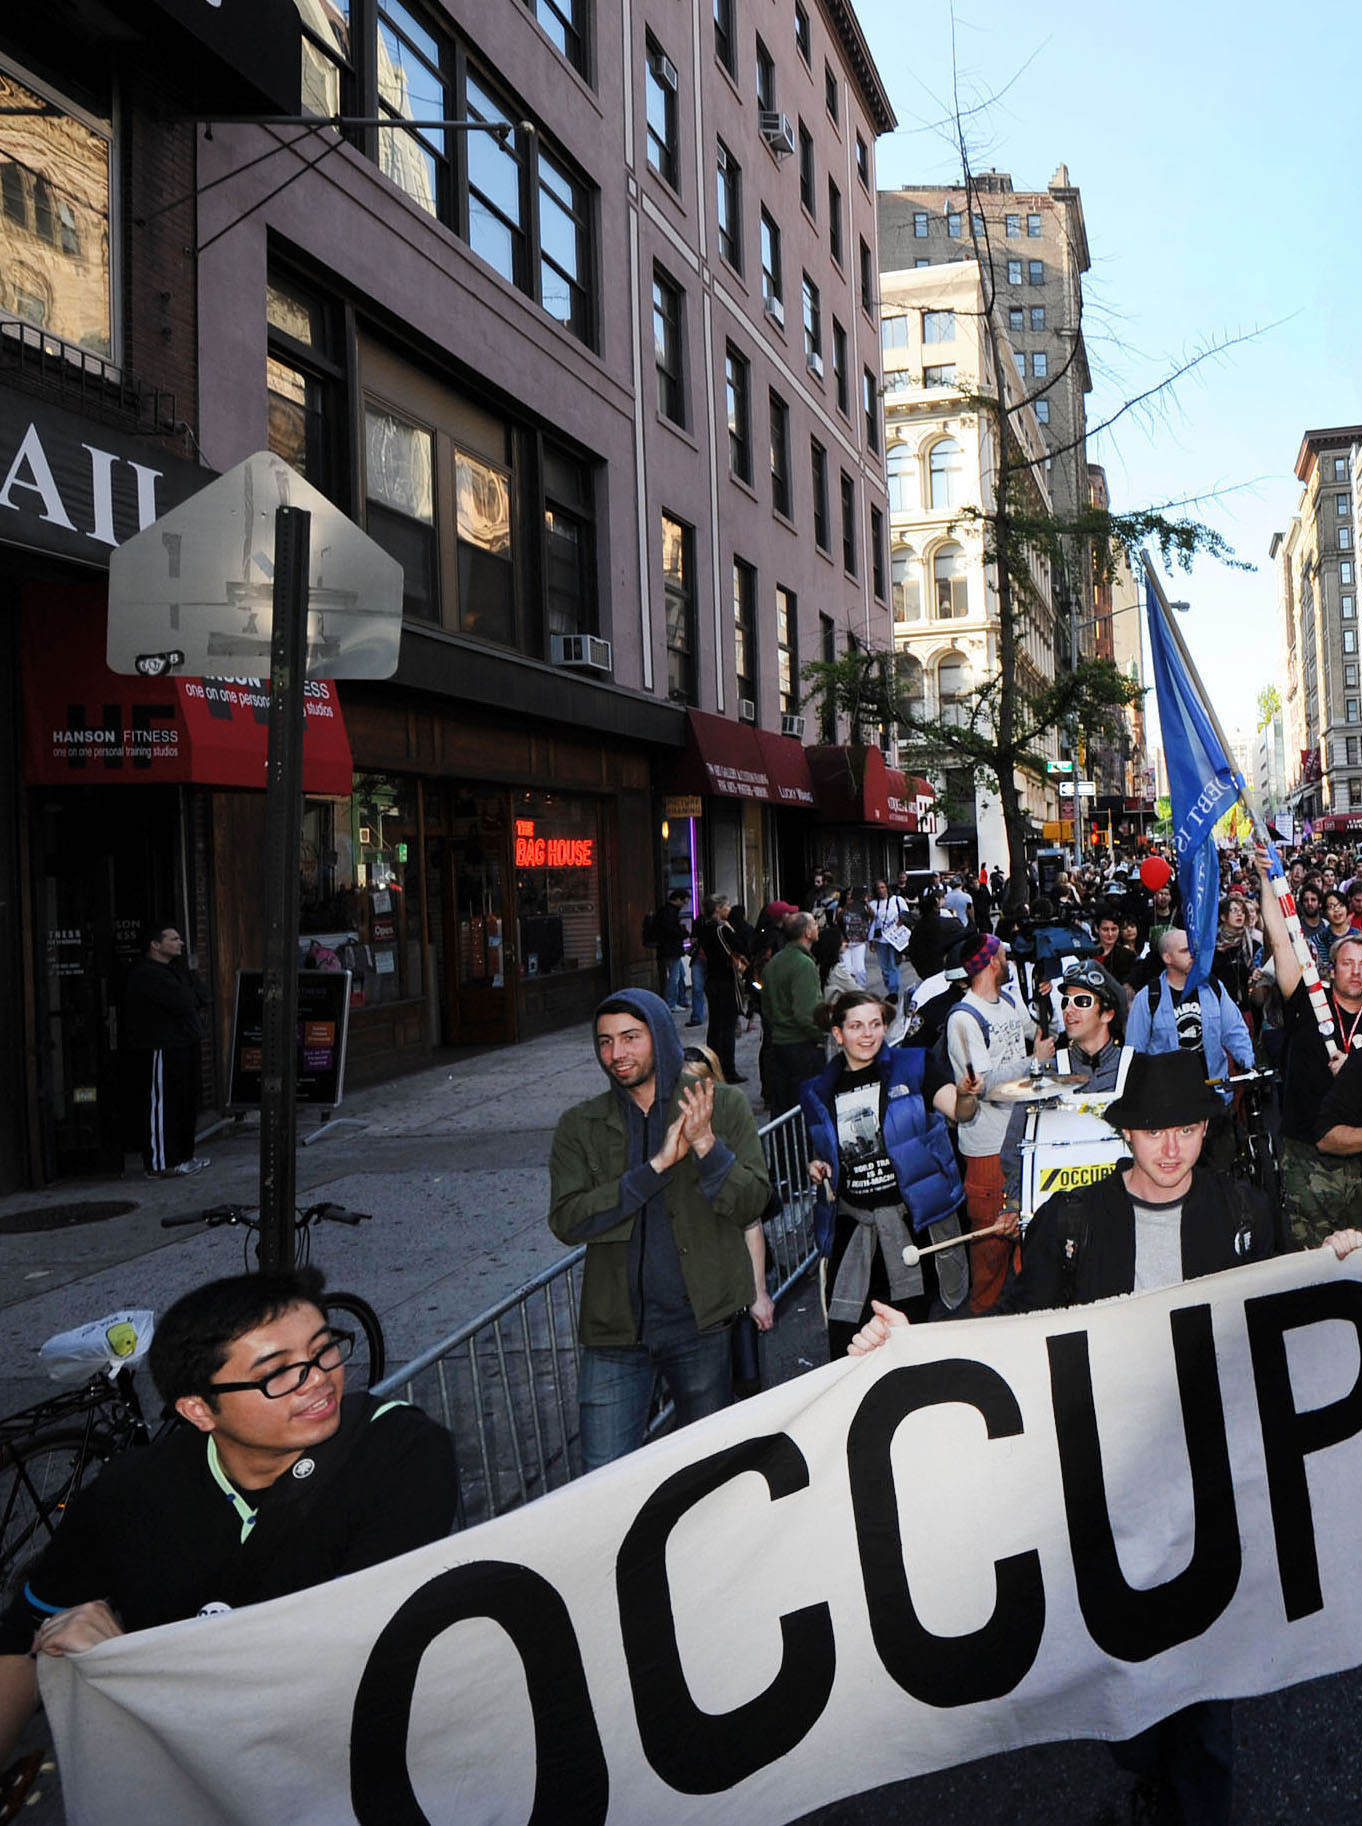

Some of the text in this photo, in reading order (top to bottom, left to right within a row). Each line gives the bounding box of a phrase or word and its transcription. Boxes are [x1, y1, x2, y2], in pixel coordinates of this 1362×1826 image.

[185, 683, 334, 718] one on one person studios
[53, 730, 178, 743] HANSON FITNESS
[94, 746, 124, 759] personal
[125, 746, 151, 759] training
[153, 745, 178, 757] studios
[516, 819, 535, 837] THE
[516, 838, 593, 867] BAG HOUSE
